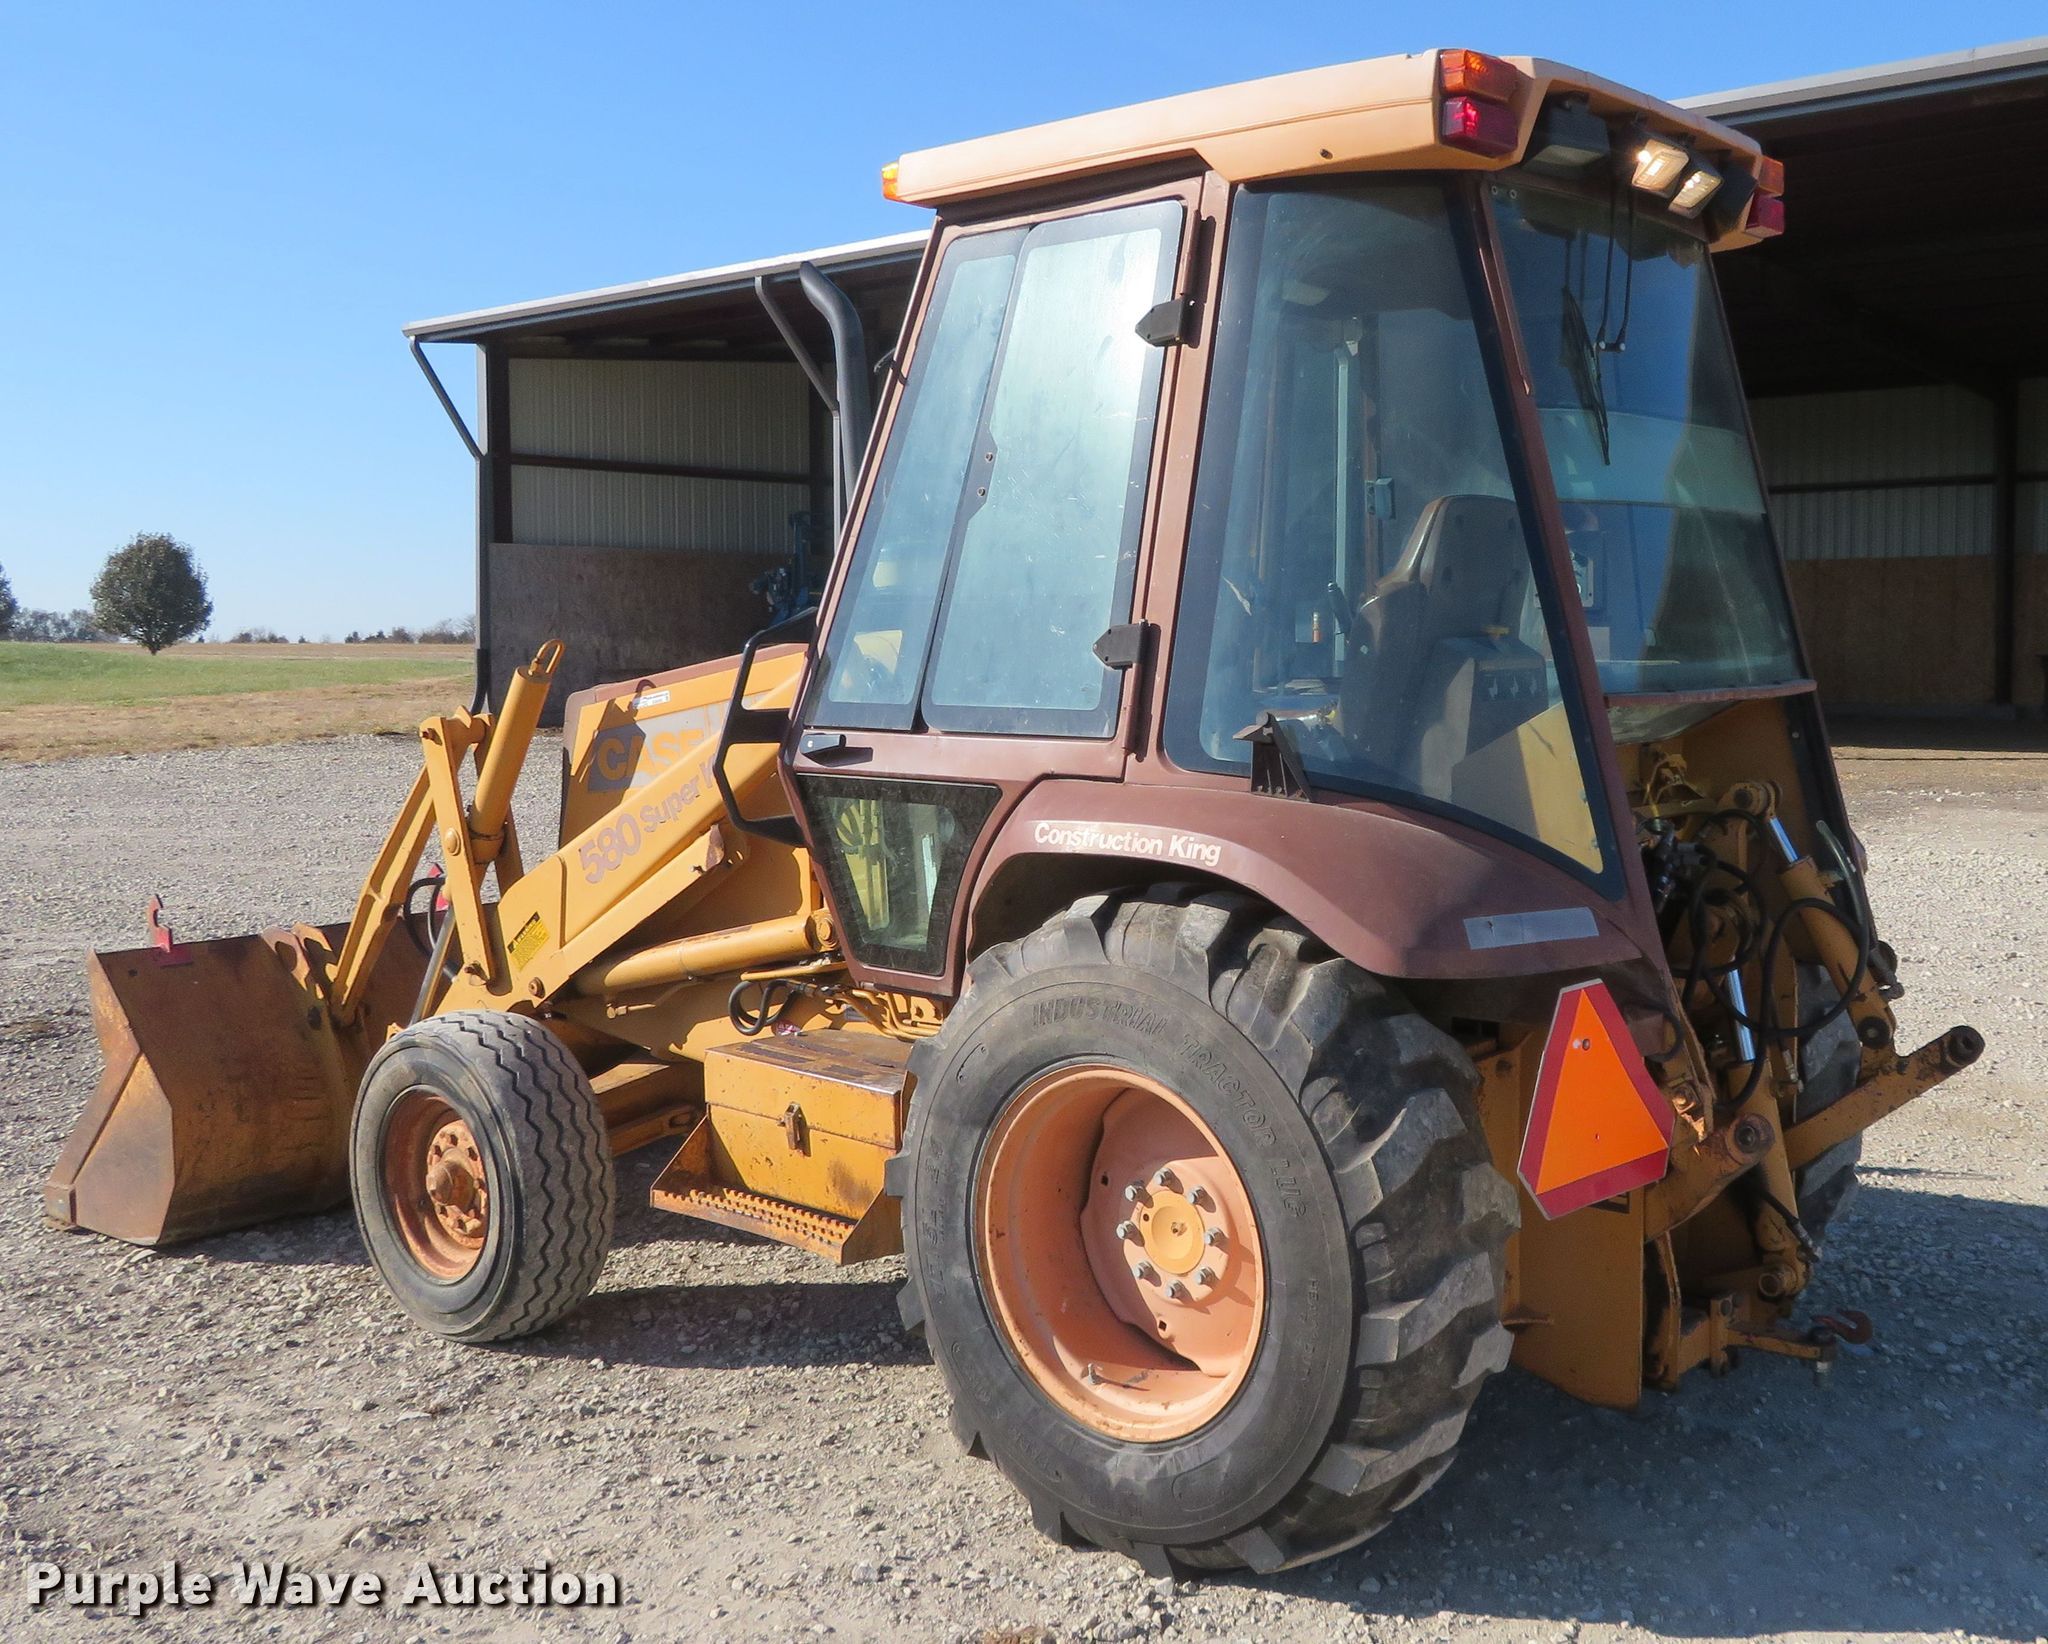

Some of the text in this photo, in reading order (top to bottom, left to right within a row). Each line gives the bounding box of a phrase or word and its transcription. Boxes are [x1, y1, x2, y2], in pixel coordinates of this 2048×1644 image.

[579, 813, 641, 884] 580
[640, 774, 699, 833] Super
[1034, 822, 1222, 867] Construction King
[1176, 1033, 1277, 1148] TRACTOR
